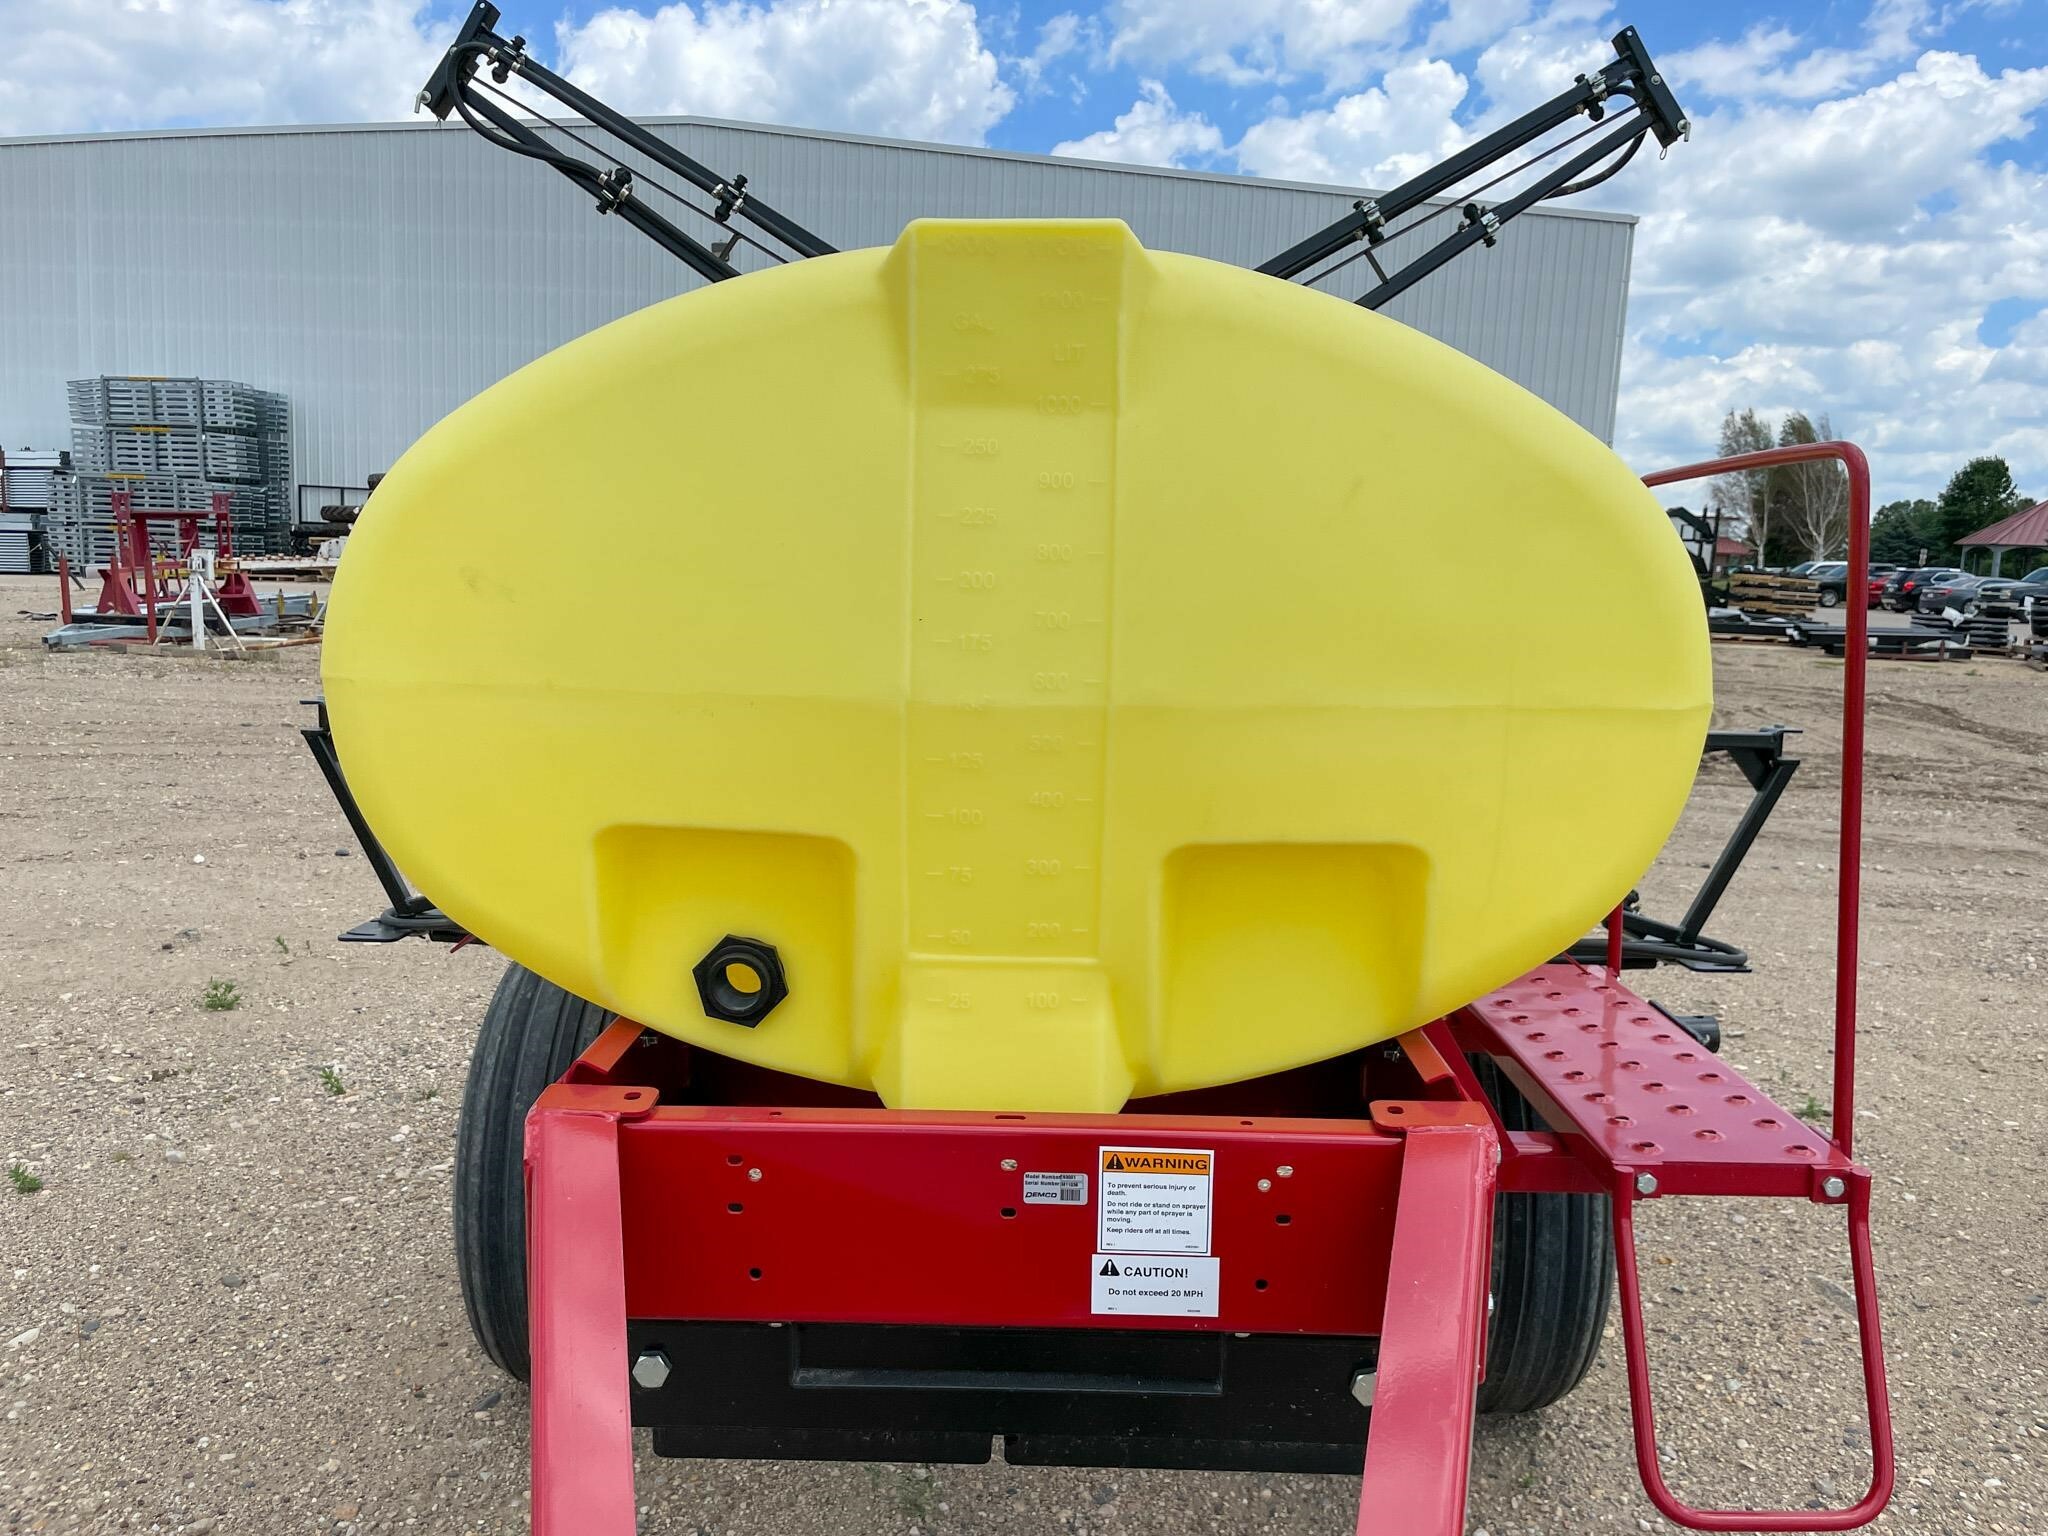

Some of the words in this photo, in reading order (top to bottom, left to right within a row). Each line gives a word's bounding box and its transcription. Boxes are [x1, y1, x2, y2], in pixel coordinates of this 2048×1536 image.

[961, 437, 999, 456] 250
[1039, 471, 1075, 489] 900
[959, 505, 998, 525] 225
[1037, 543, 1073, 561] 800
[959, 570, 996, 589] 200
[1033, 610, 1071, 630] 700
[957, 633, 993, 651] 175
[1029, 791, 1064, 808] 400
[950, 808, 984, 825] 100
[948, 866, 973, 883] 75
[1025, 858, 1062, 876] 300
[948, 929, 971, 946] 50
[1026, 922, 1062, 939] 200
[948, 992, 971, 1010] 25
[1025, 991, 1059, 1010] 100
[1125, 1158, 1207, 1170] WARNING
[1124, 1267, 1188, 1278] CAUTION!
